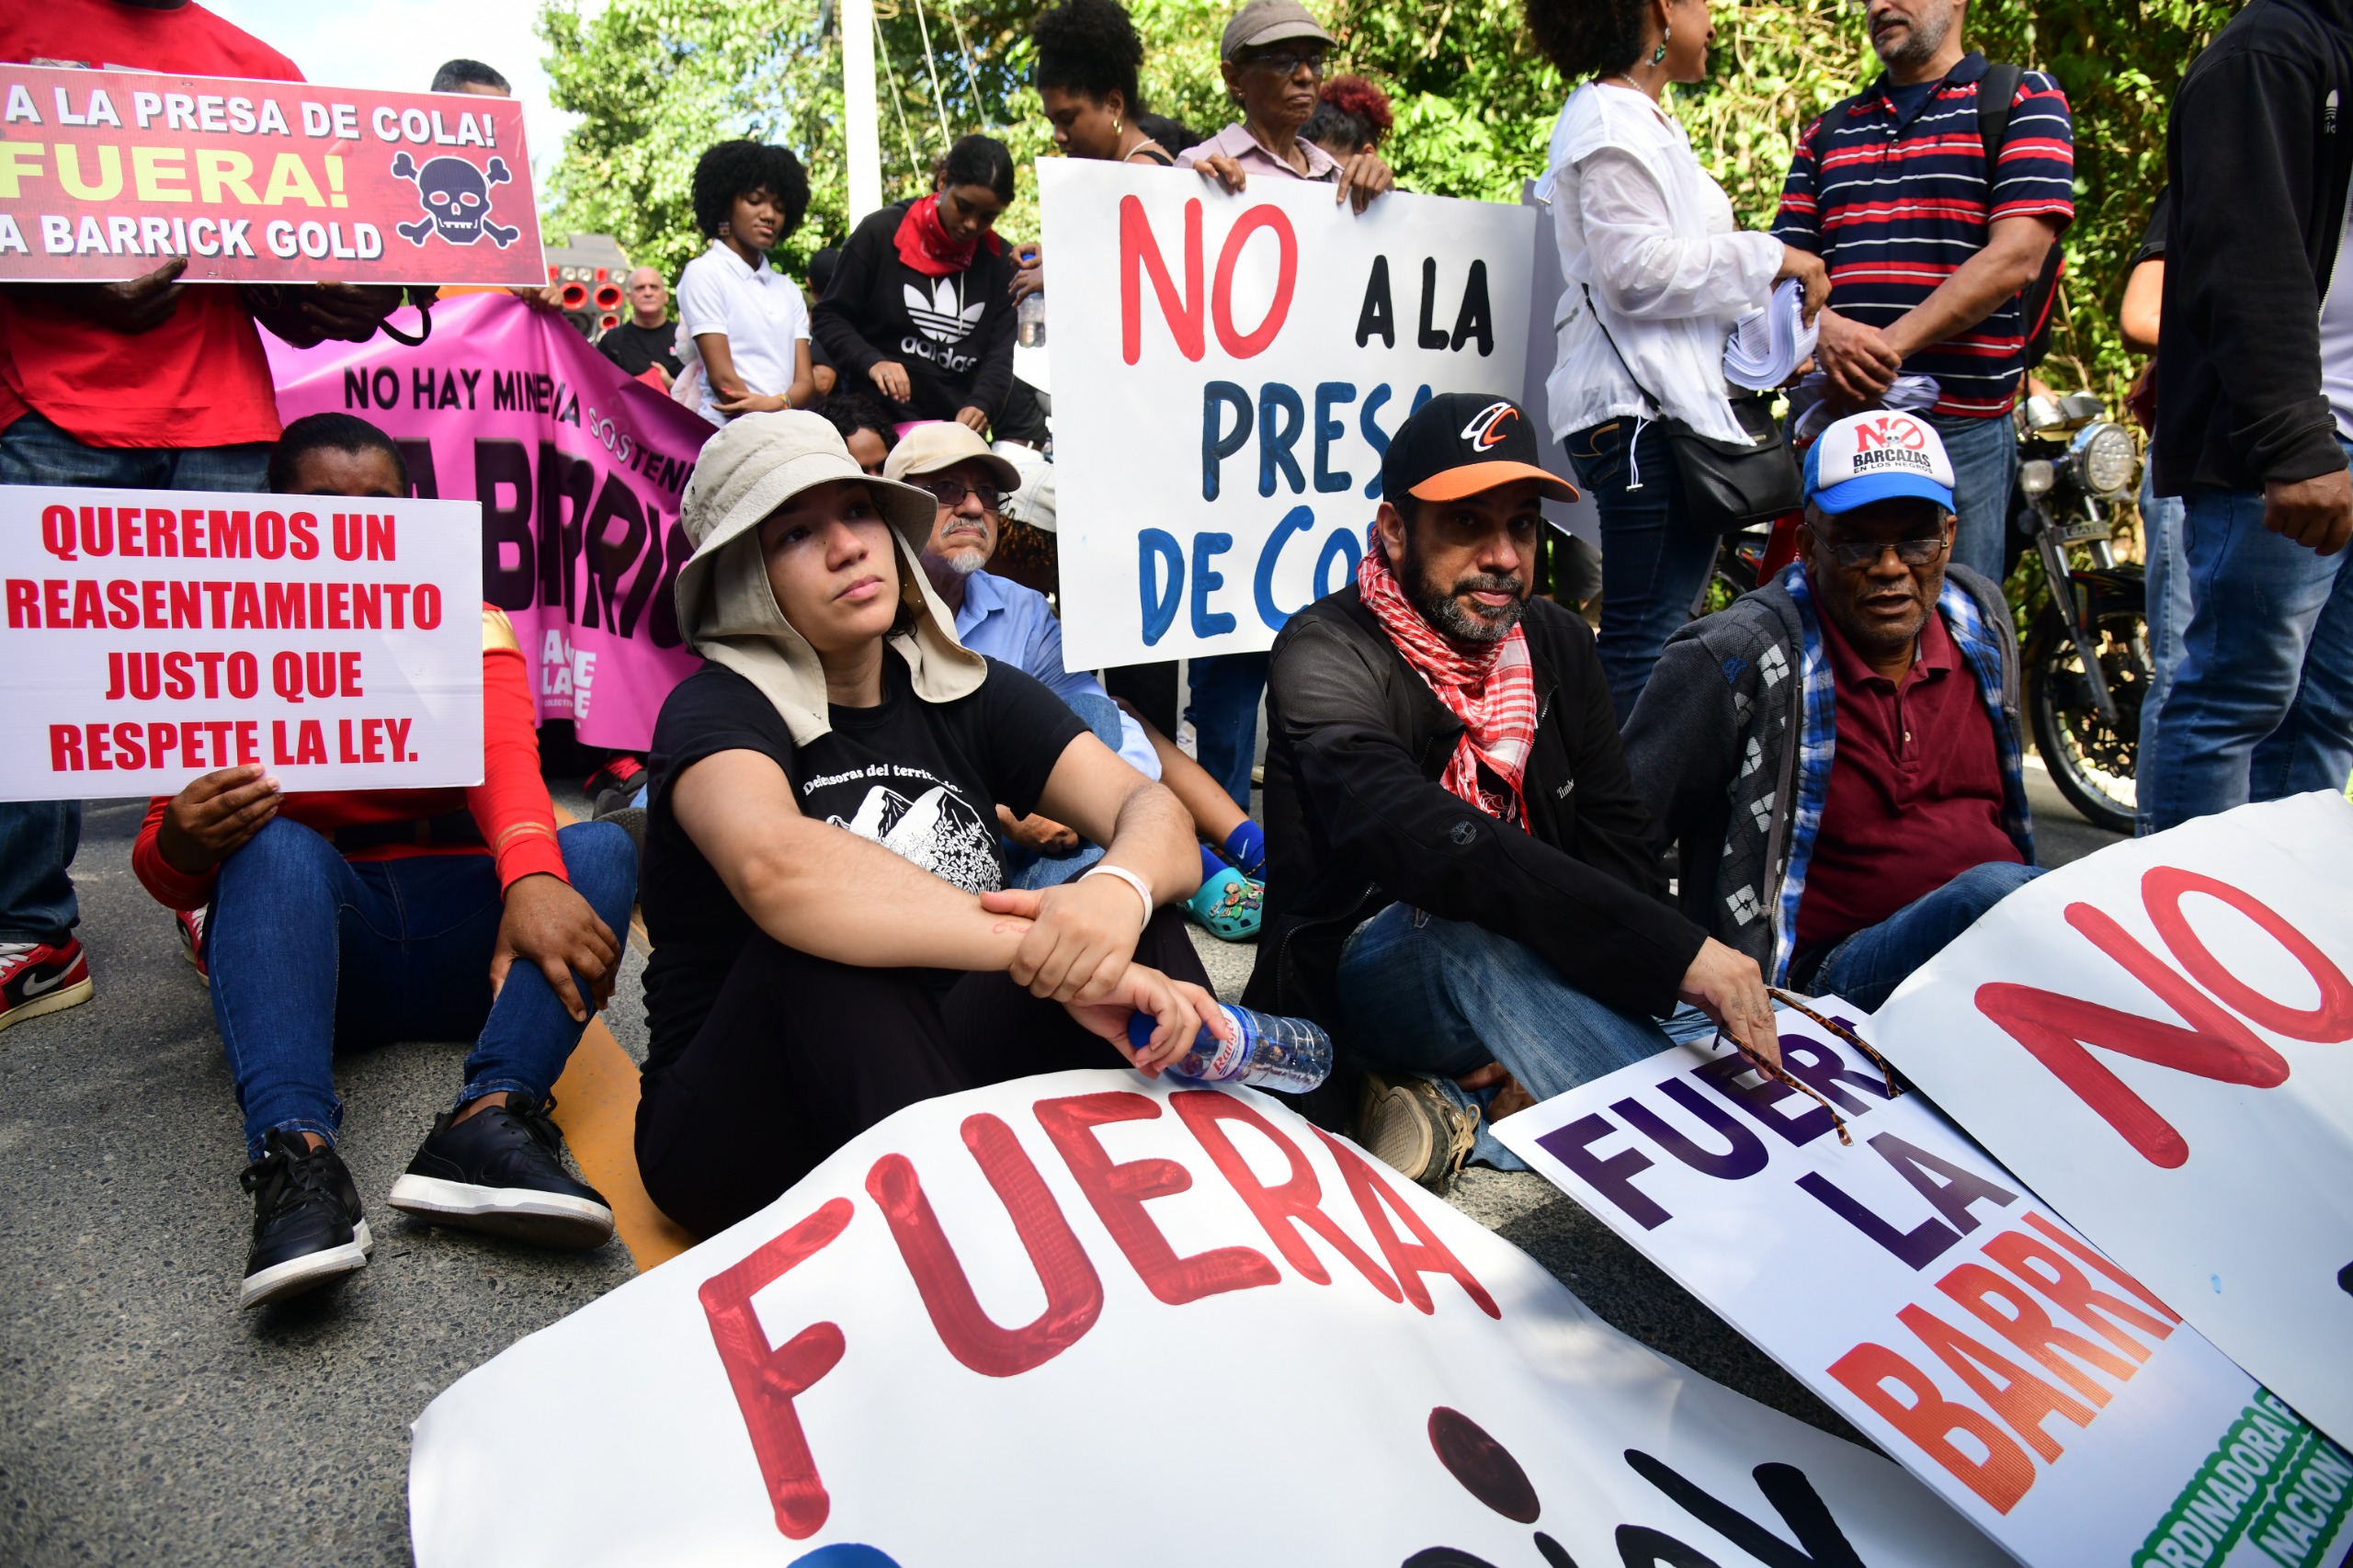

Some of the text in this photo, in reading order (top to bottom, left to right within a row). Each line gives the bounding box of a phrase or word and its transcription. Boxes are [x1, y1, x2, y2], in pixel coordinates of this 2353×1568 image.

[5, 85, 496, 148] A LA PRESA DE COLA!
[0, 141, 349, 209] FUERA!
[40, 214, 256, 258] BARRICK
[267, 220, 384, 260] GOLD
[1119, 194, 1495, 366] NO A LA
[344, 366, 400, 410] NO
[412, 367, 483, 411] HAY
[493, 369, 582, 428] MINEIA
[1201, 380, 1433, 503] PRES
[1852, 448, 1931, 469] BARCAZAS
[1853, 460, 1933, 474] EN LOS NEGROS
[41, 504, 396, 562] QUEREMOS UN
[6, 578, 442, 631] REASENTAMIENTO
[1138, 505, 1381, 647] DE CO
[106, 651, 363, 703] JUSTO QUE
[49, 718, 419, 772] RESPETE LA LEY.
[866, 764, 889, 778] del
[1973, 865, 2353, 1169] NO
[1794, 1131, 2019, 1272] LA
[698, 1089, 1502, 1540] FUERA
